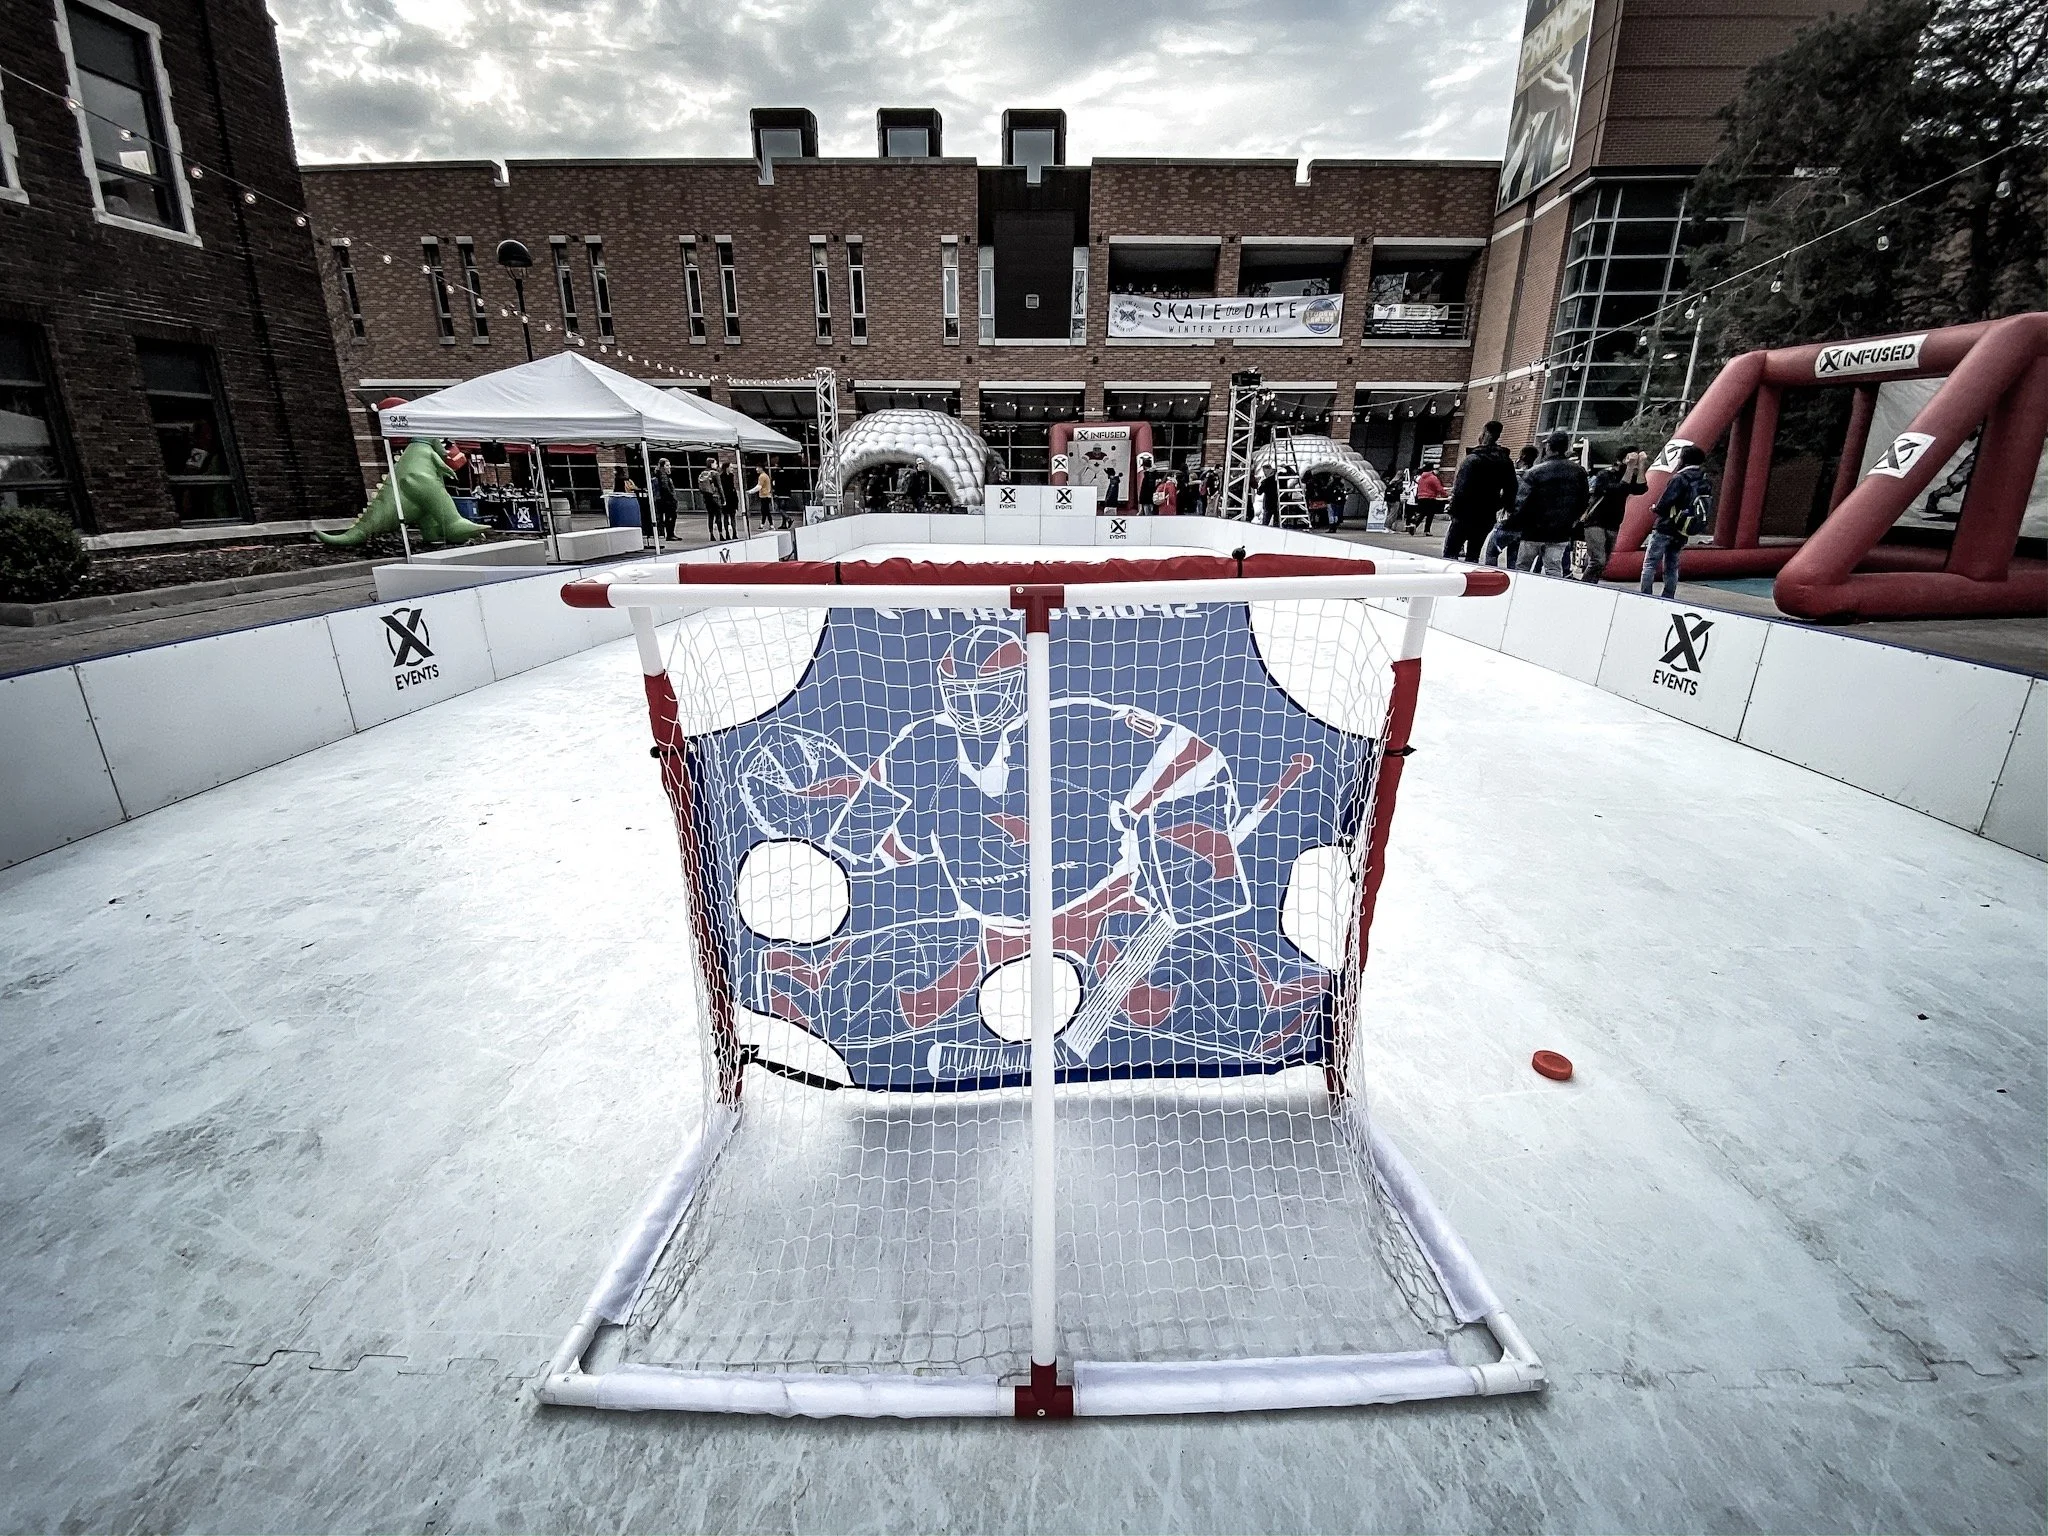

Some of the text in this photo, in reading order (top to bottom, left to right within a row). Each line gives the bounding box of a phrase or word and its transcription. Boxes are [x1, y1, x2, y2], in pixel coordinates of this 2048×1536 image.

[1152, 301, 1297, 323] SKATE the DATE
[1168, 325, 1278, 333] WINTER FESTIVAL
[1843, 343, 1916, 367] INFUSED
[1090, 431, 1127, 440] INFUSED
[395, 664, 439, 691] EVENTS
[1652, 669, 1698, 696] EVENTS
